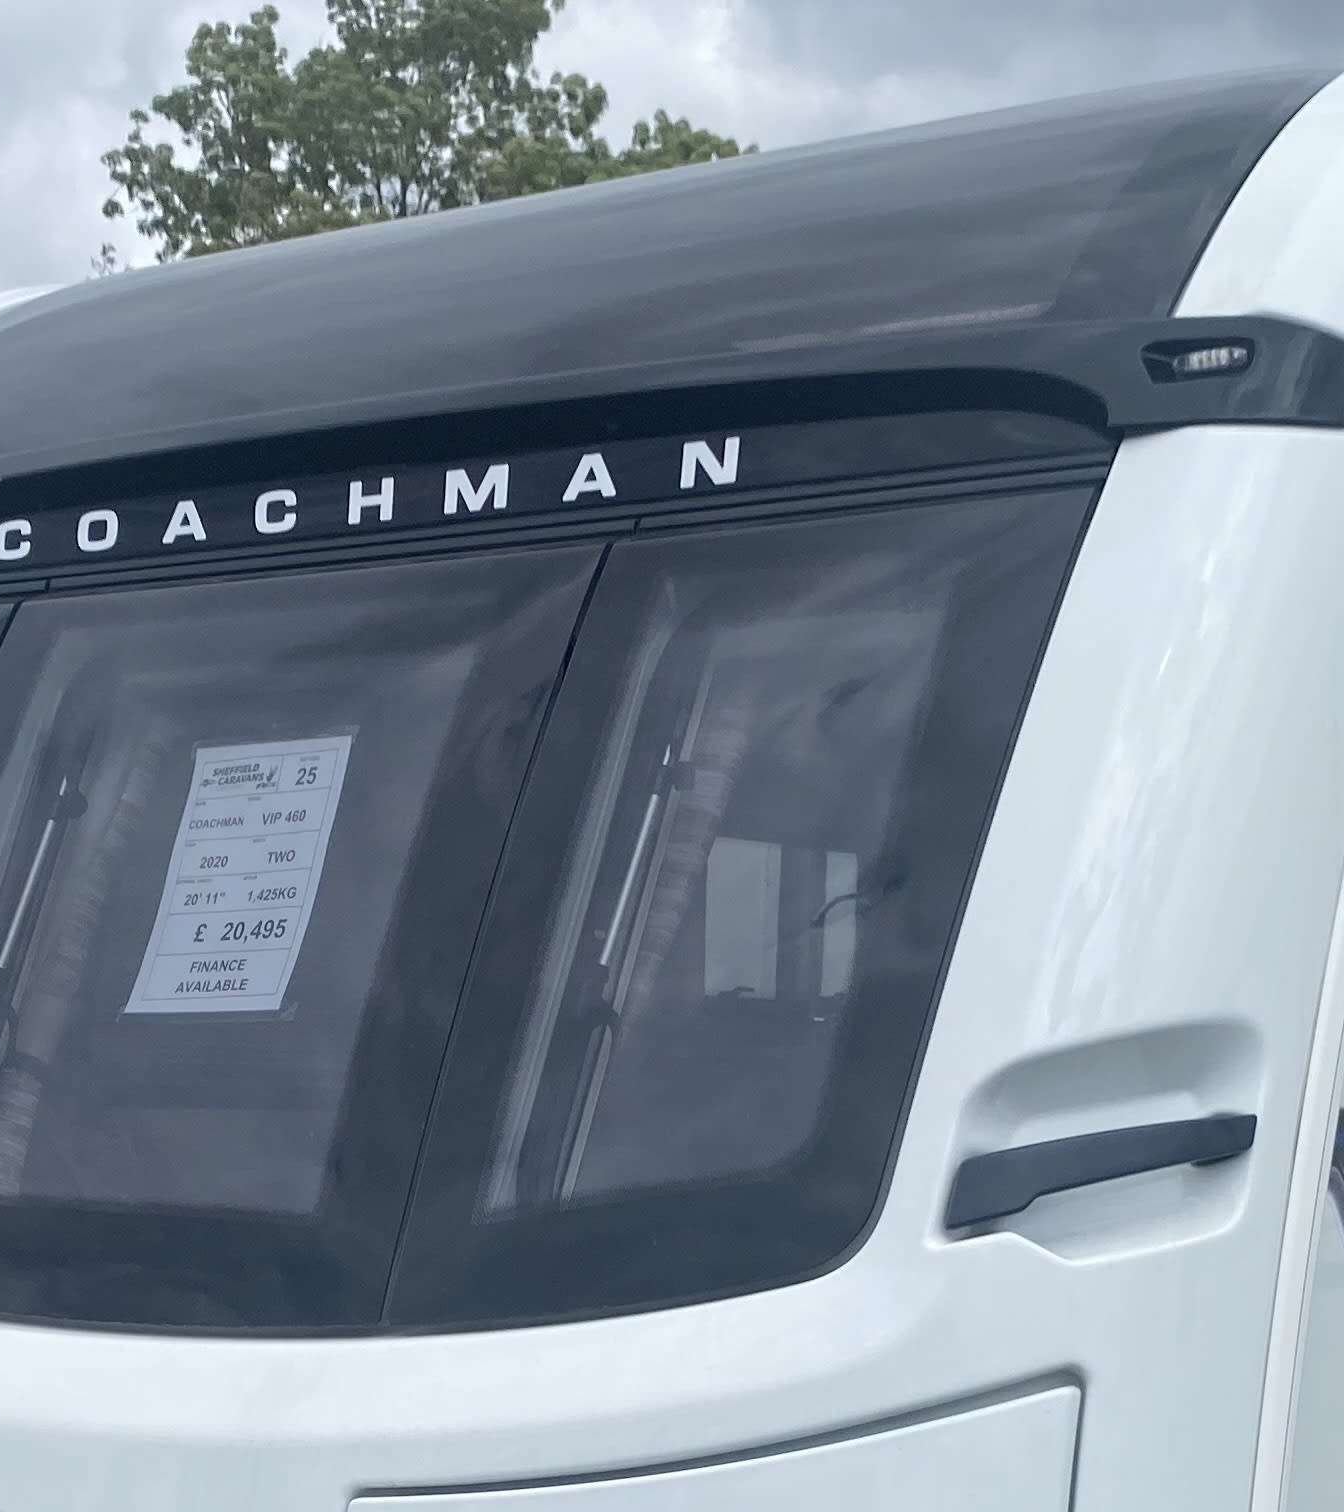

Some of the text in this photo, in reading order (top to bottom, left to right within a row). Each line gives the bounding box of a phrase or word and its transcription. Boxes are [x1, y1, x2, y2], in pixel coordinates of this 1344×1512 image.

[212, 763, 260, 776] SHEFFIELD
[295, 766, 318, 786] 25
[218, 773, 264, 786] CARAVANS
[189, 816, 244, 830] COACHMAN
[262, 809, 307, 826] VIP 460
[199, 855, 229, 869] 2020
[267, 850, 296, 864] TWO
[247, 886, 297, 903] 1,425KG
[193, 918, 288, 943] £ 20,495
[190, 959, 248, 973] FINANCE
[175, 979, 249, 994] AVAILABLE
